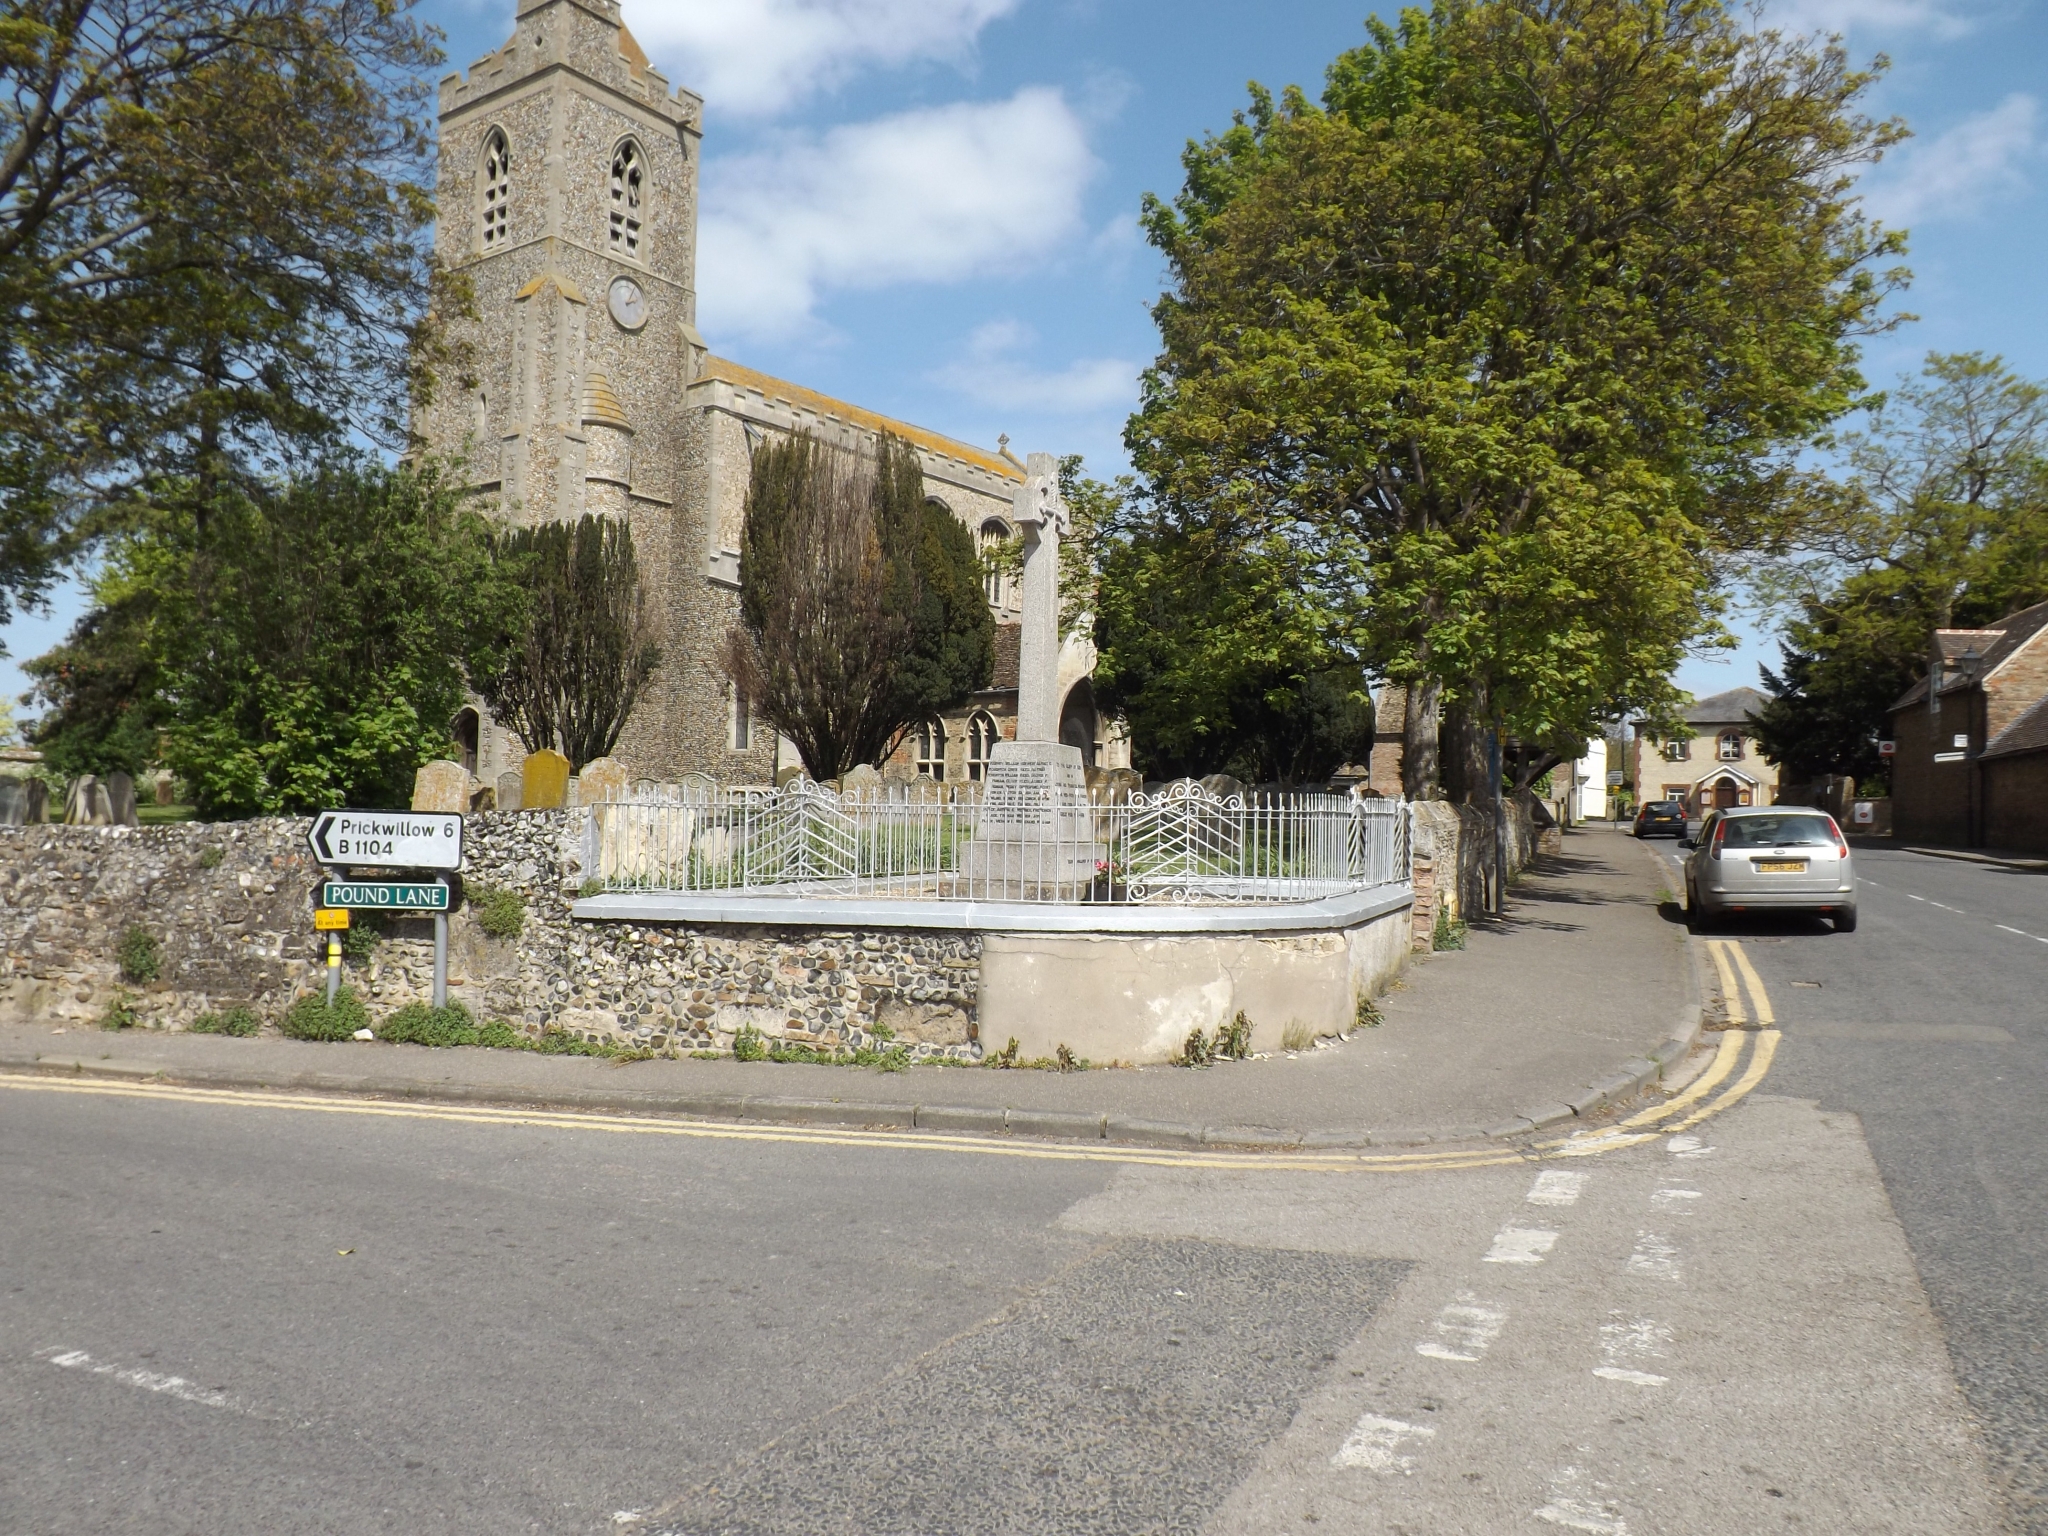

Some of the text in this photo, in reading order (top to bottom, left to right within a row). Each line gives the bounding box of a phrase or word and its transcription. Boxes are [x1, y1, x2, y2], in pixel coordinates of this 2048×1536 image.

[341, 819, 454, 838] Prickwillow 6
[339, 839, 393, 855] B 1104
[332, 887, 440, 905] POUND LANE
